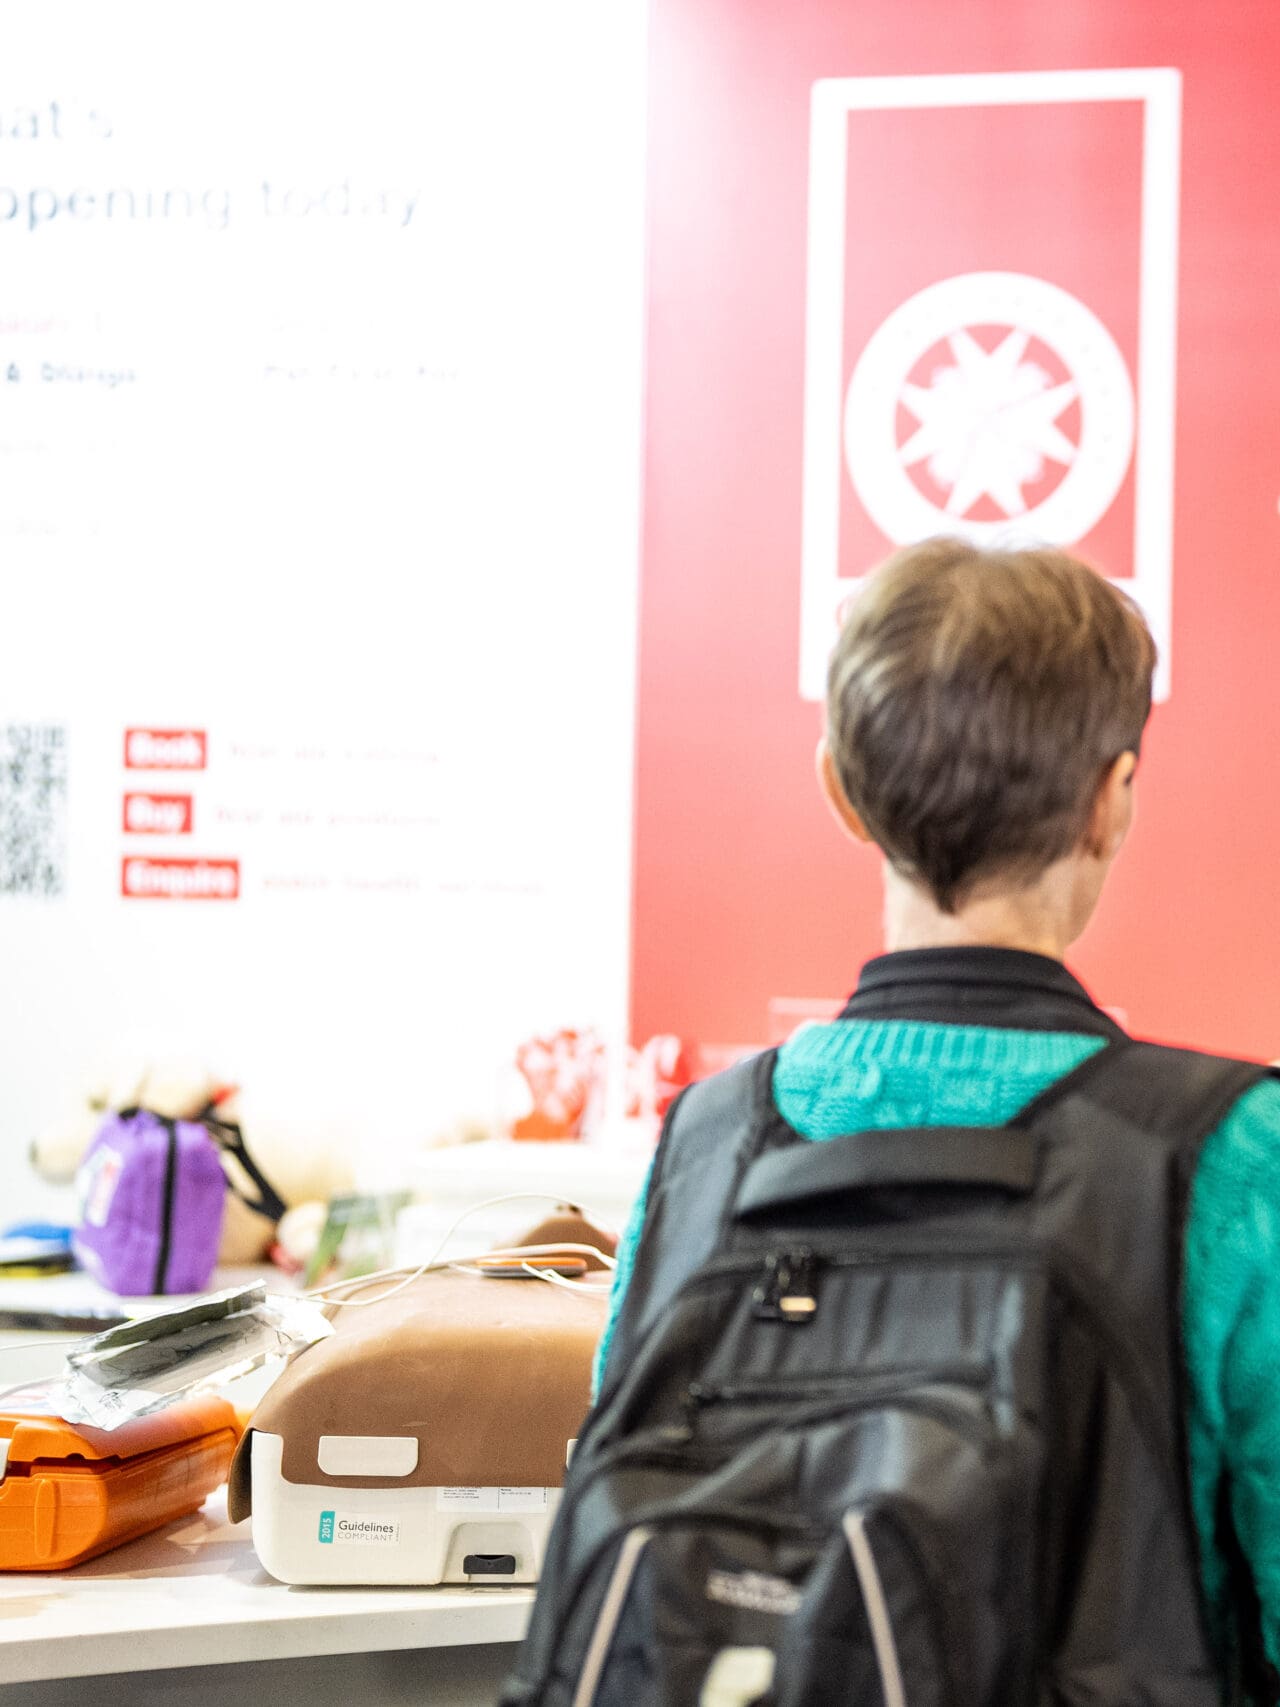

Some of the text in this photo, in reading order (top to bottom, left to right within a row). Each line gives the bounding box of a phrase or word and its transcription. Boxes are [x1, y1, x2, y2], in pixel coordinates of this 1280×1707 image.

[321, 1517, 333, 1539] 2015
[338, 1520, 394, 1533] Guidelines
[337, 1531, 393, 1541] COMPLIANT
